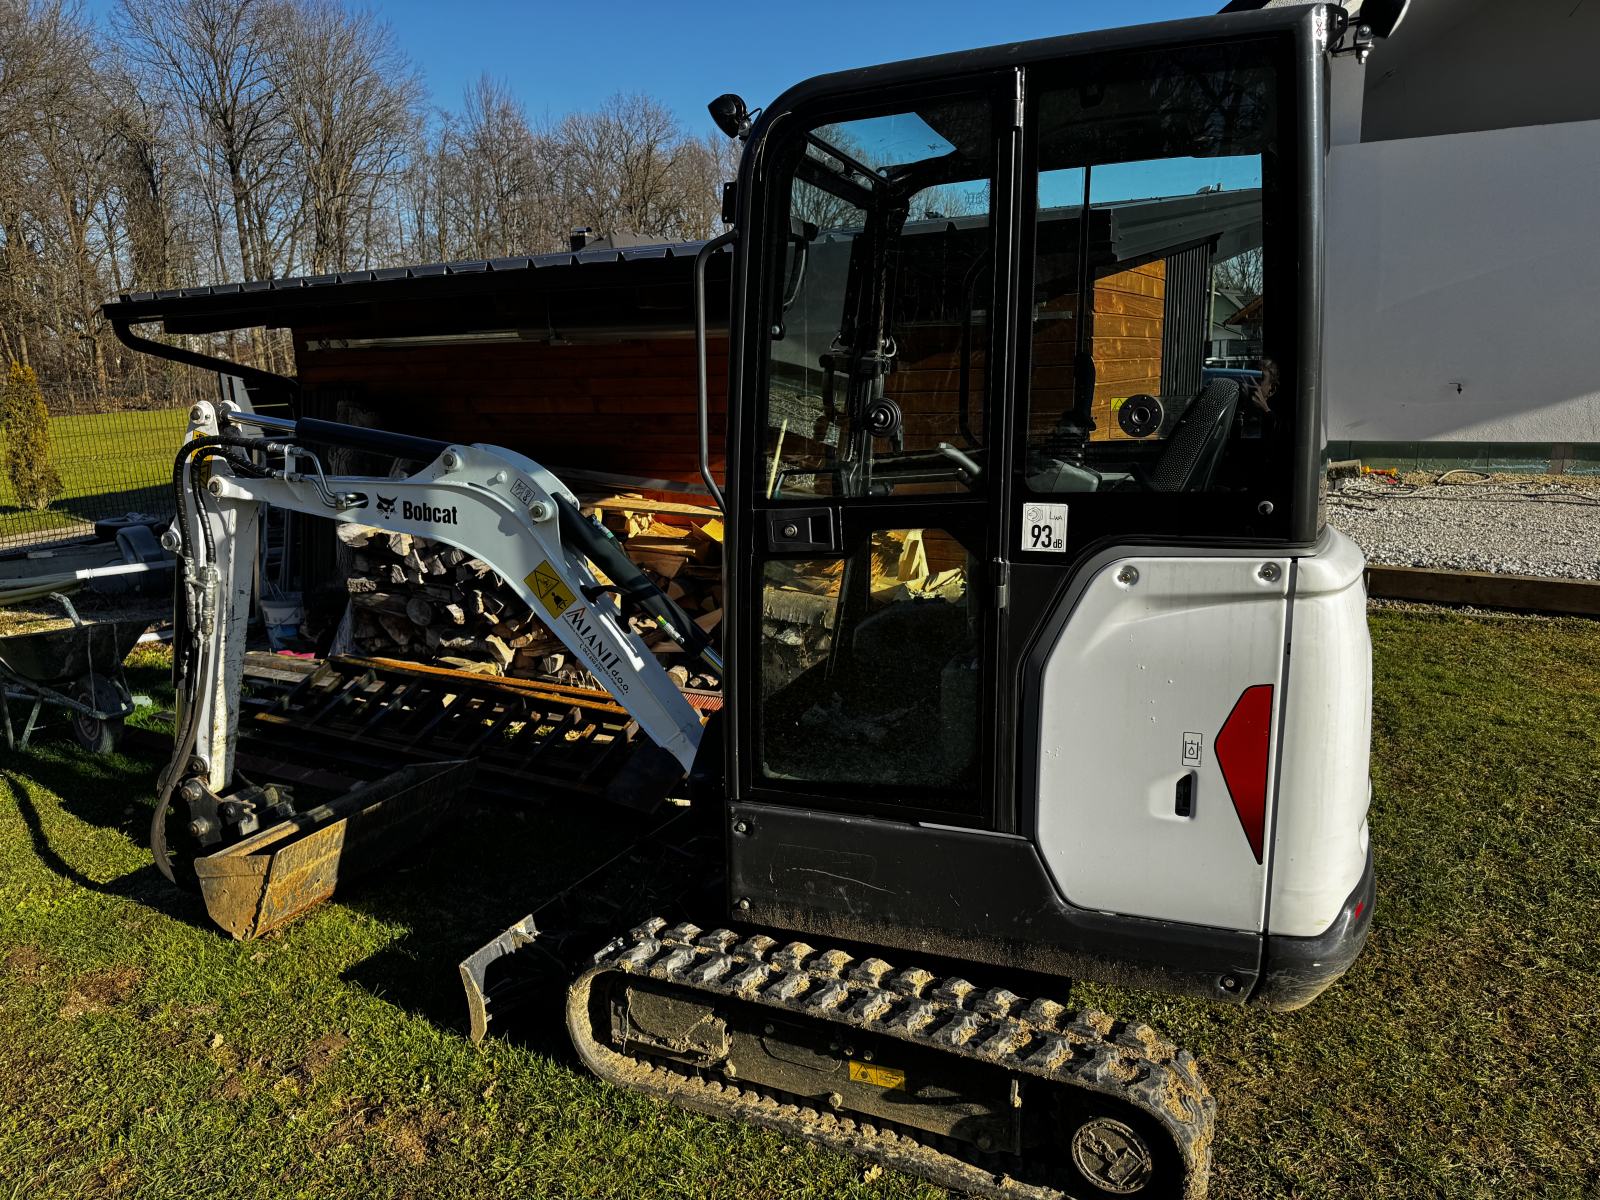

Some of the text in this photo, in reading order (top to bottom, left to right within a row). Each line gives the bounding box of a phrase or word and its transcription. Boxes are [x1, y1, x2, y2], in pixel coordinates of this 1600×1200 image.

[402, 500, 458, 525] Bobcat
[1031, 524, 1063, 549] 93 dB
[565, 607, 622, 670] MIANIT
[611, 669, 629, 694] d.o.o.
